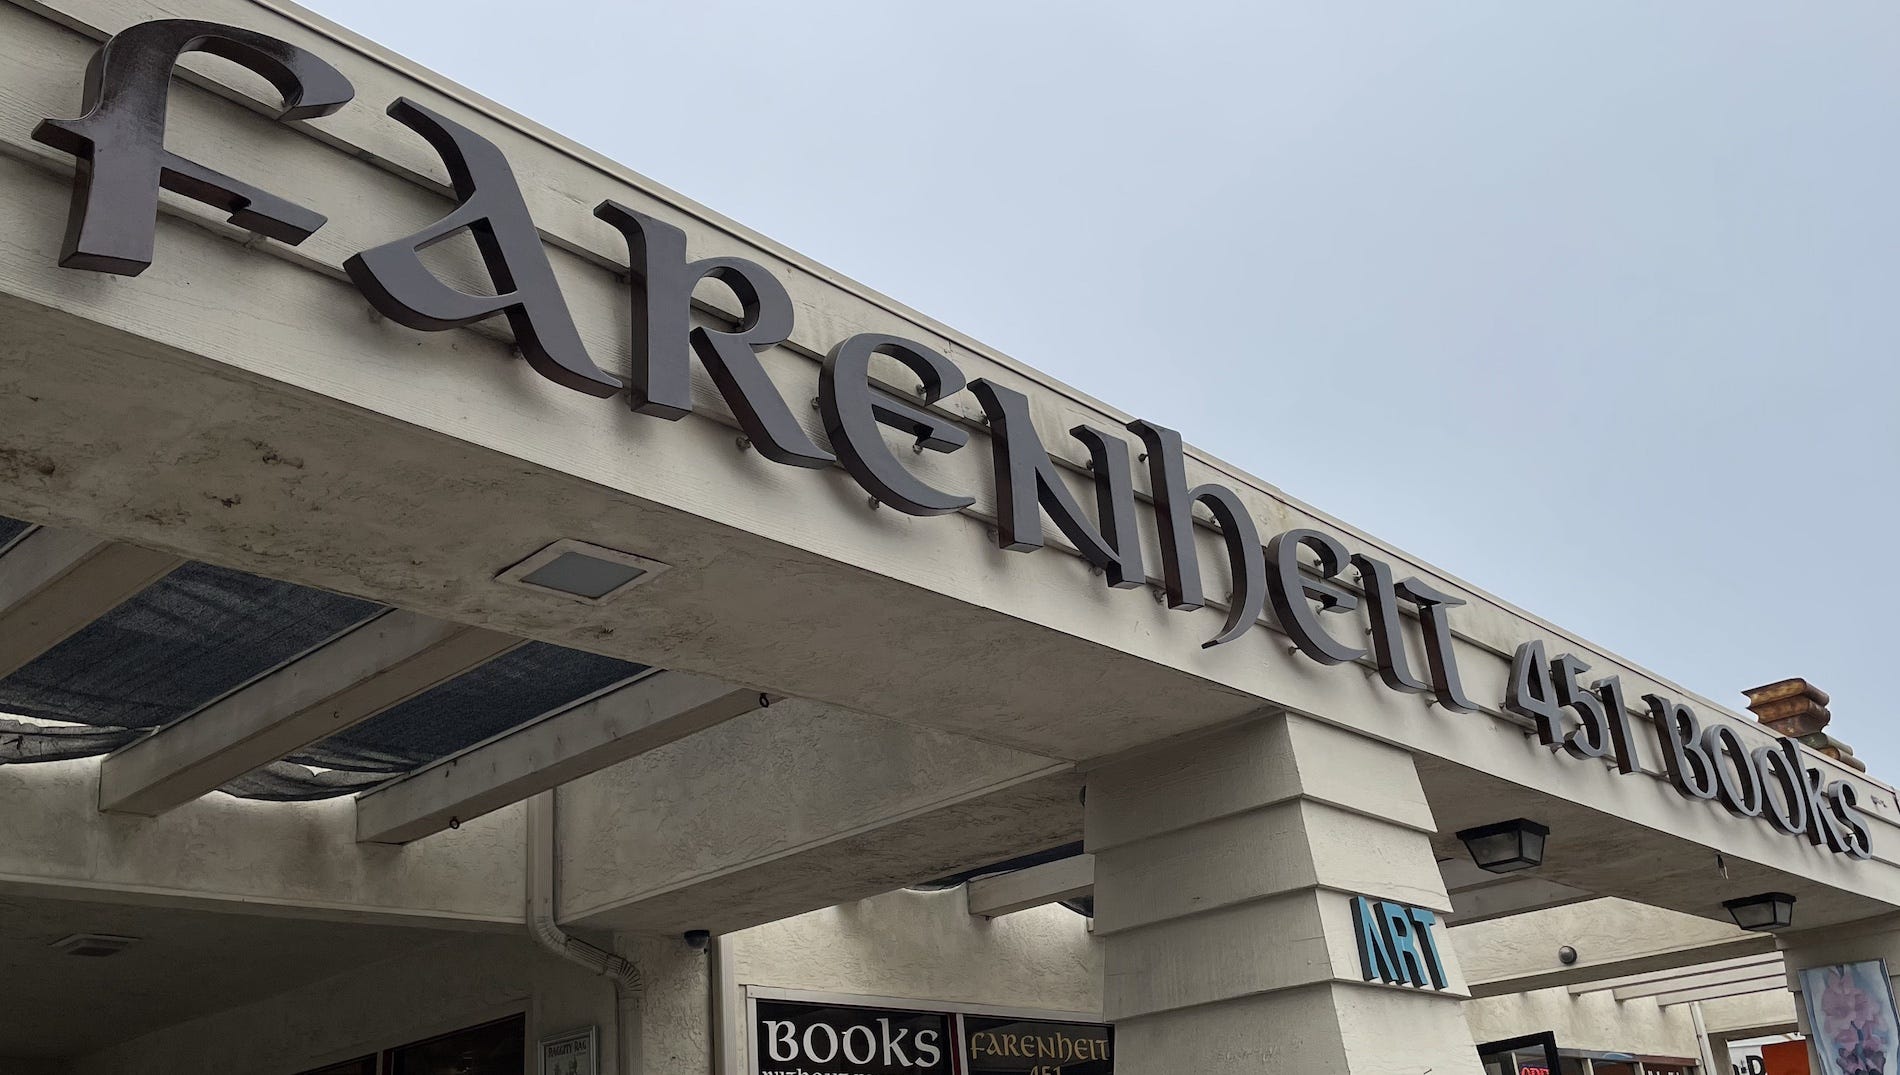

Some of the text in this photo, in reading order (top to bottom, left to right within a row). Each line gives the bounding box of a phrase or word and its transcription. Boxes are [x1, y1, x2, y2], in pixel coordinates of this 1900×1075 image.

[1506, 639, 1641, 776] 451
[1641, 693, 1873, 861] BOOKS
[1350, 895, 1449, 991] ART
[762, 1017, 941, 1068] BOOKS
